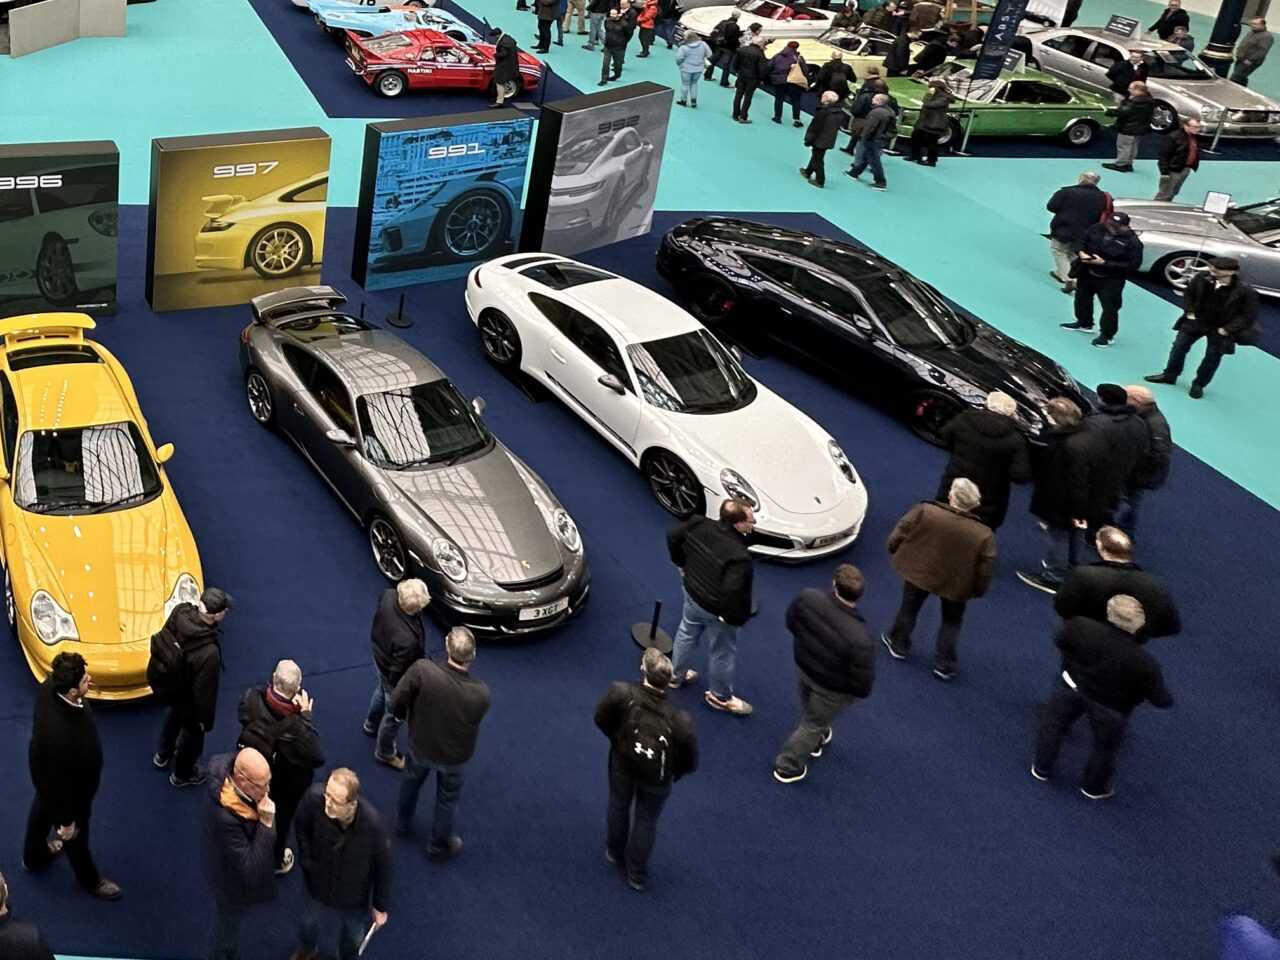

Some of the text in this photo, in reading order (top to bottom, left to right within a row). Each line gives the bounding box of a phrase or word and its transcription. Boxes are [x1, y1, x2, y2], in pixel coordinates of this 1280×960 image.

[598, 115, 640, 134] 992
[428, 143, 485, 159] 991
[213, 161, 279, 178] 997
